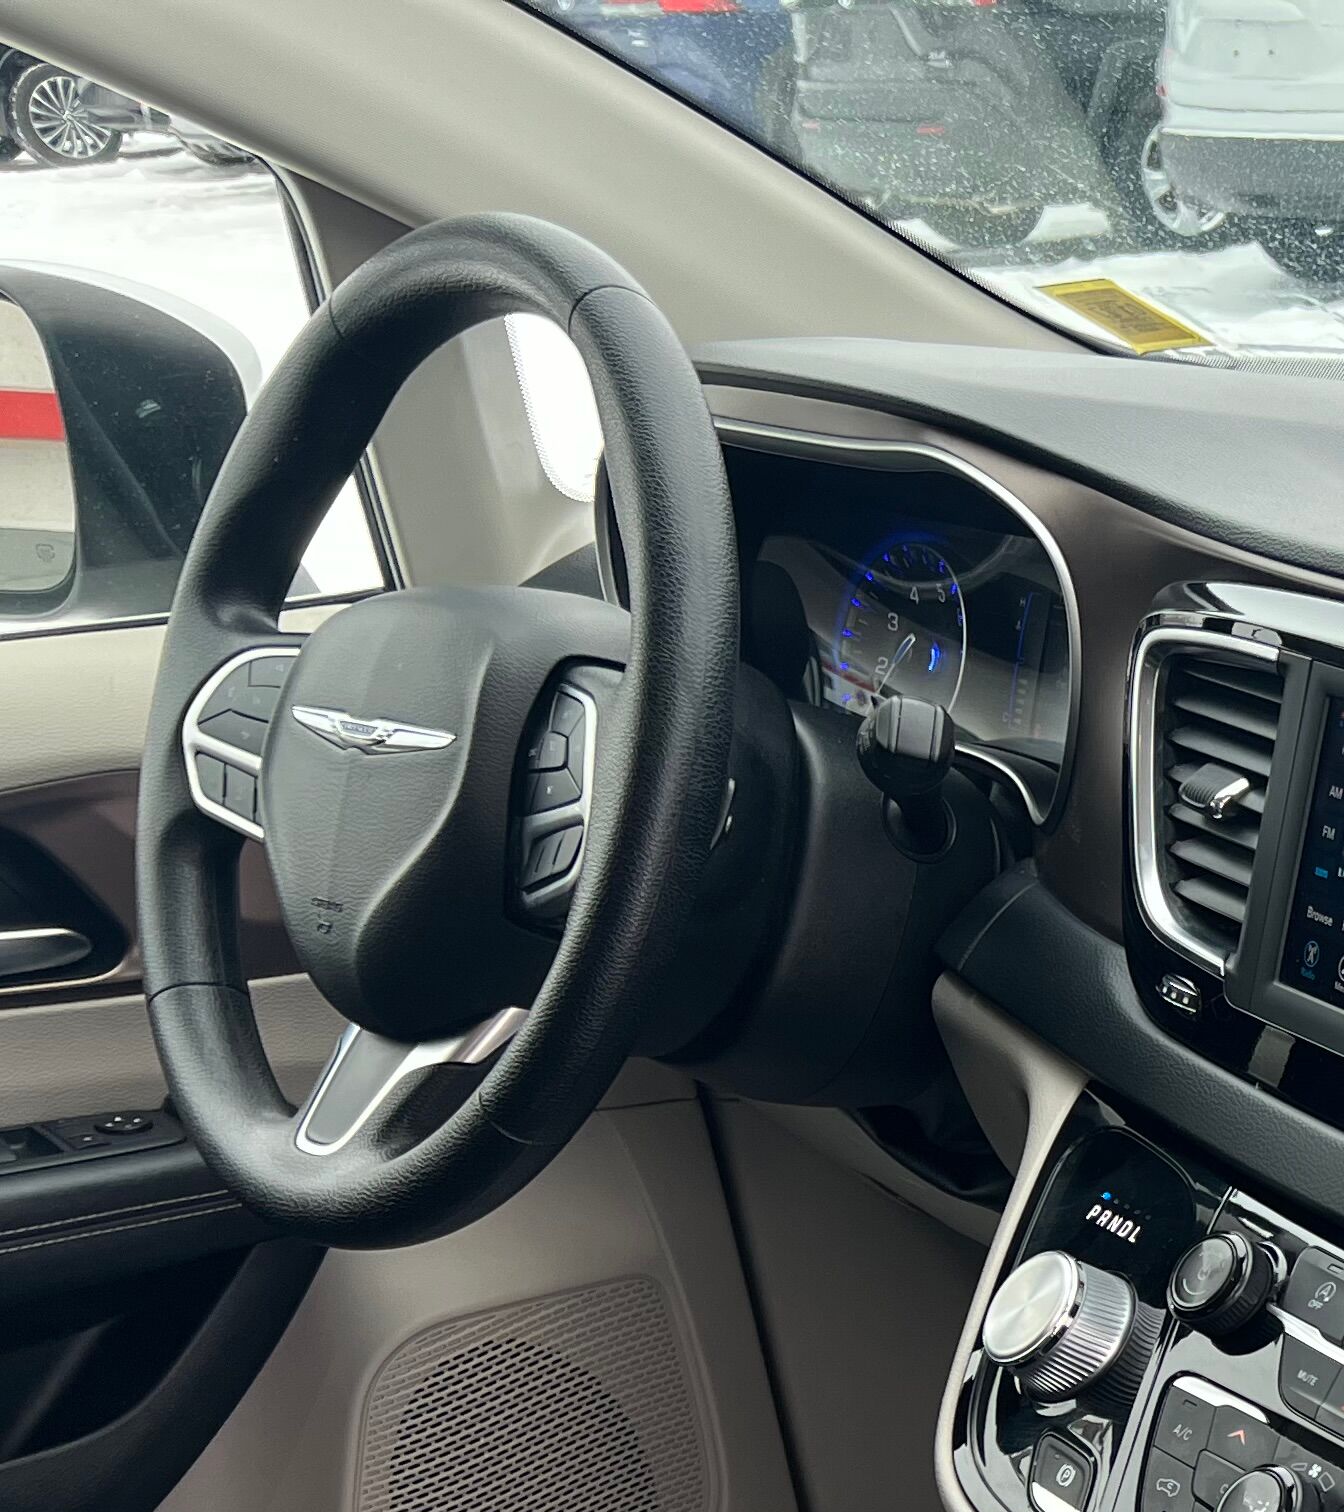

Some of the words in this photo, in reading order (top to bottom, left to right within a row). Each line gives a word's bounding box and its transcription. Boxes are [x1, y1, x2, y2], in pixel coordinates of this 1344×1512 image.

[909, 586, 920, 605] 4
[934, 583, 946, 603] 5
[887, 612, 899, 632] 3
[875, 656, 889, 676] 2
[1329, 785, 1343, 800] AM
[1321, 825, 1336, 840] FM
[1306, 905, 1333, 927] Browse
[1085, 1204, 1141, 1243] PRNDL
[1308, 1299, 1324, 1311] OFF
[1297, 1369, 1319, 1387] MUTE
[1172, 1423, 1193, 1441] A/C
